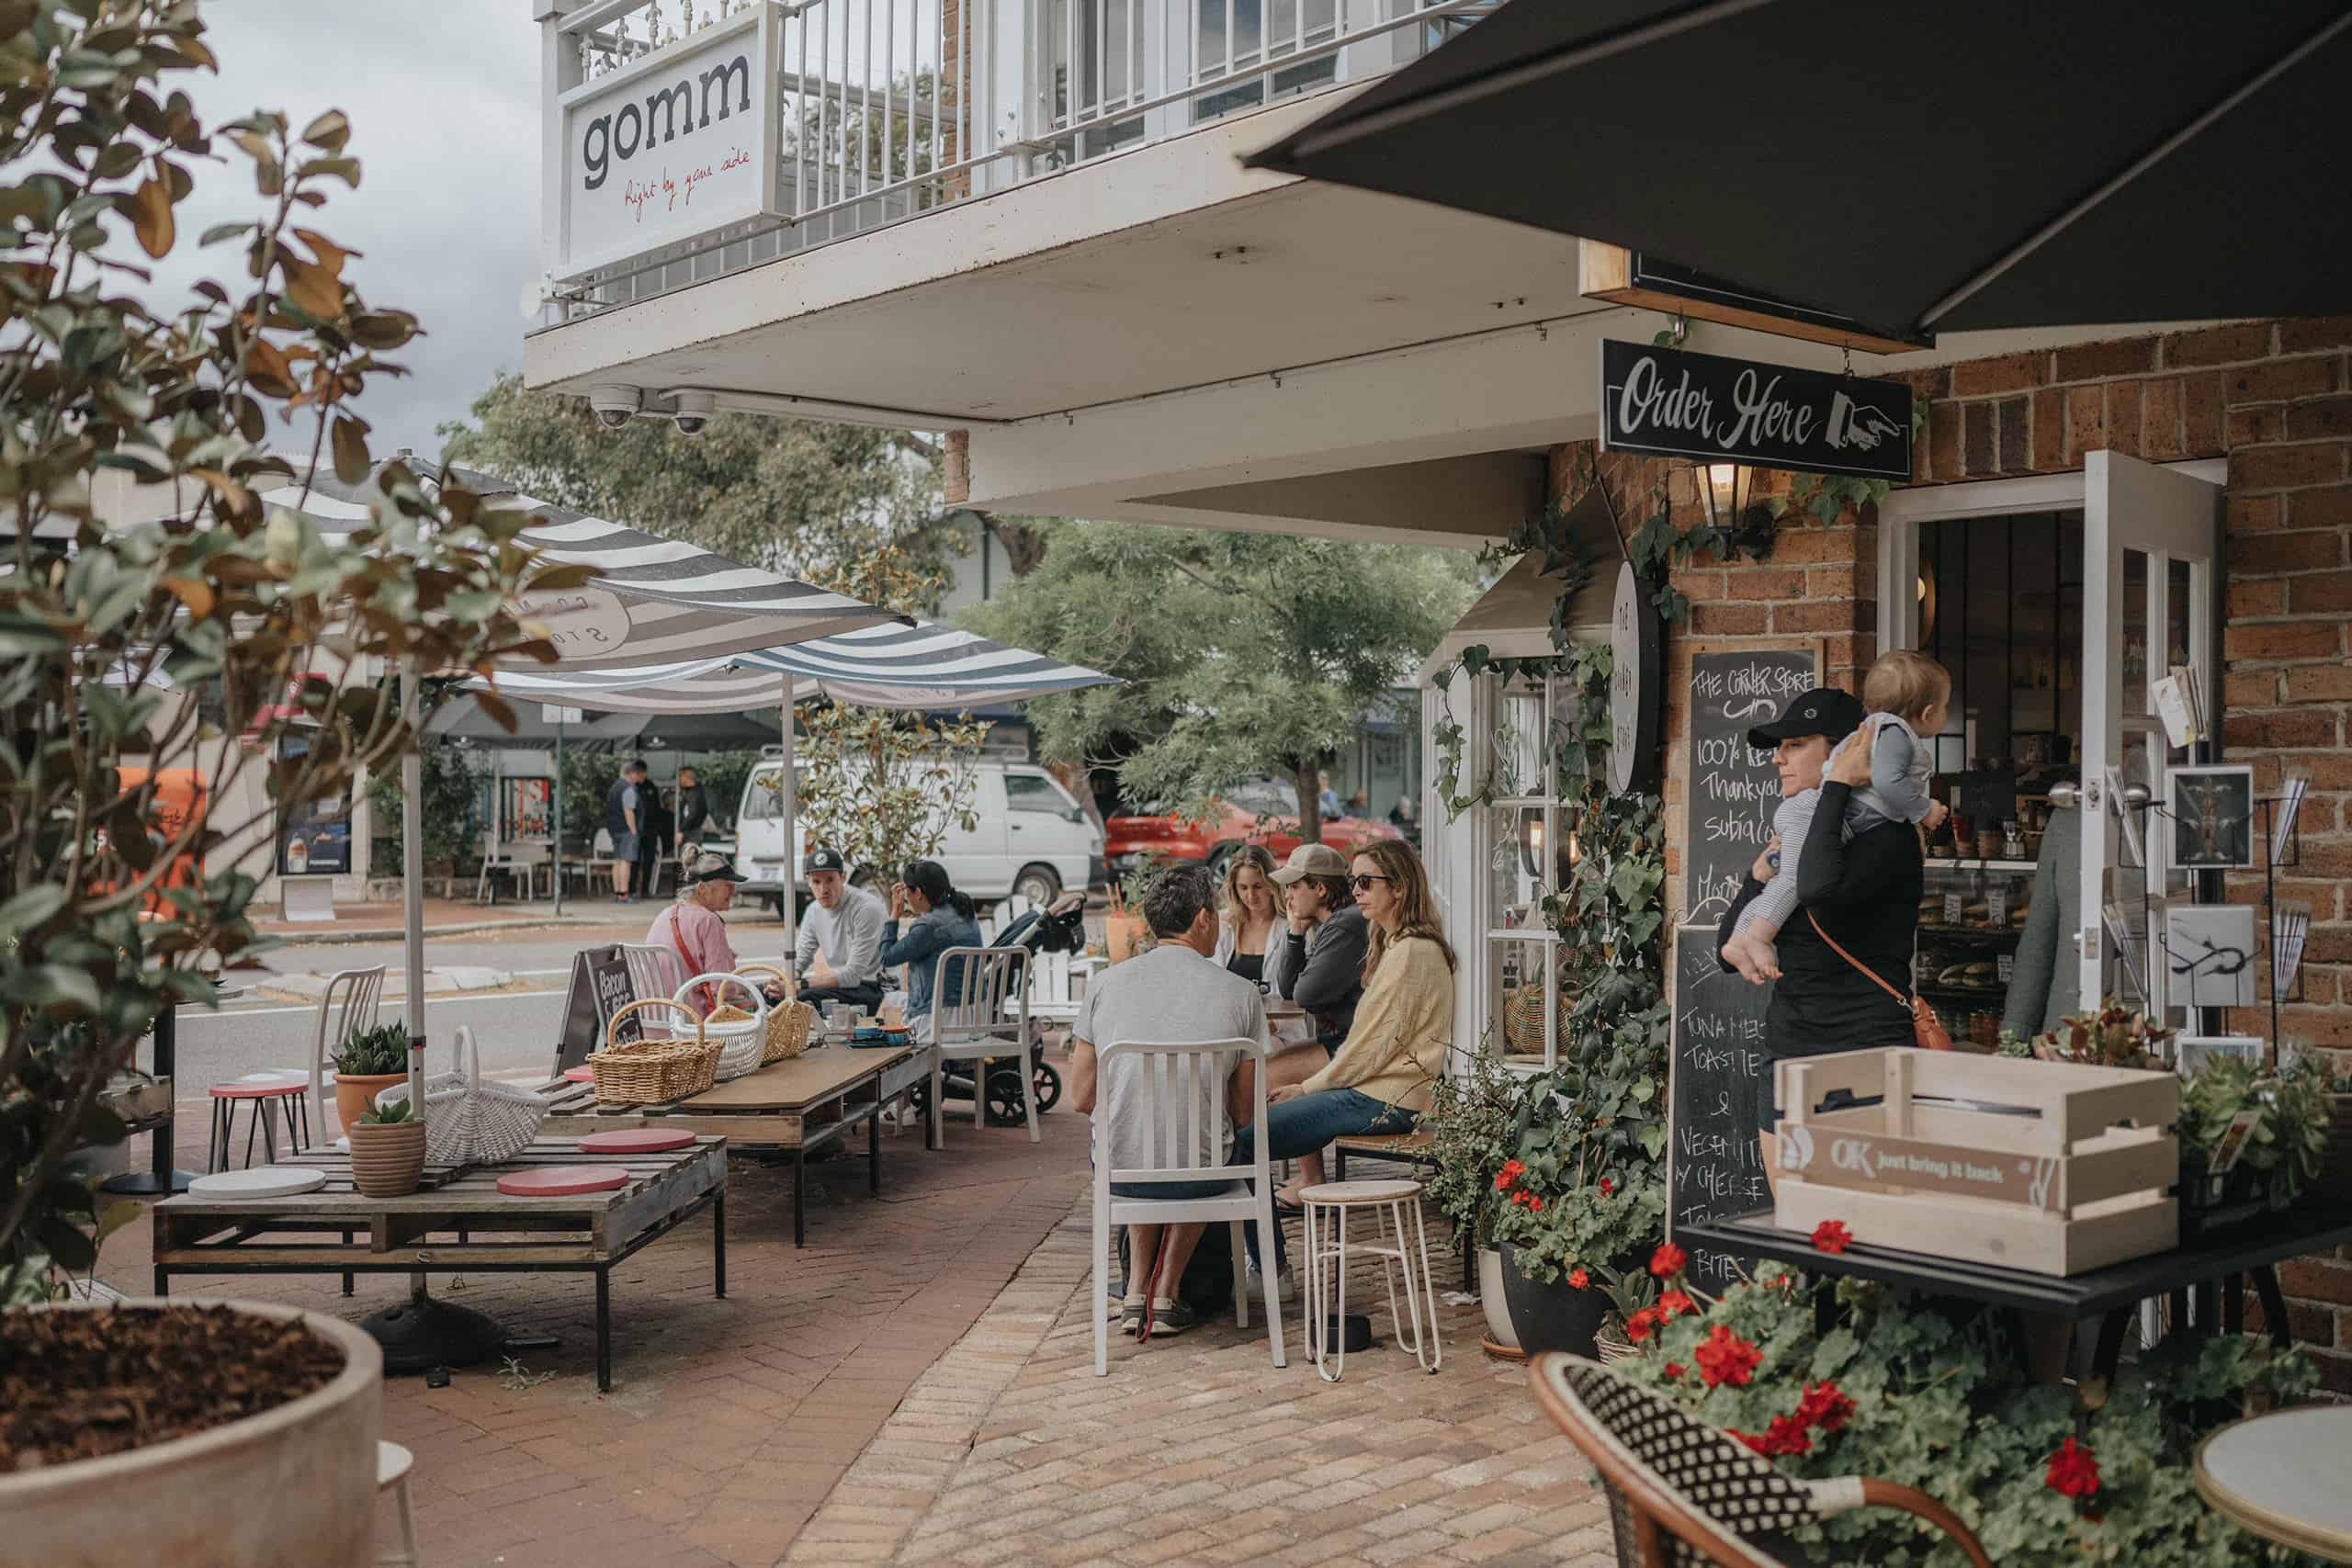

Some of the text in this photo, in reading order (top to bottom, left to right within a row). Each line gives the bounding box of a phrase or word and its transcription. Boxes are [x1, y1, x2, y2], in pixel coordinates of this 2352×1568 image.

[583, 55, 751, 190] gomm
[662, 165, 677, 212] by
[684, 164, 713, 206] your
[720, 146, 750, 172] side
[1619, 355, 1824, 449] Order Here
[1690, 660, 1816, 698] THE CORNER STORE
[1698, 732, 1740, 770] 100%
[1679, 1007, 1727, 1040] TUNA
[1830, 1138, 1877, 1179] OK
[1908, 1154, 1948, 1180] bring
[1951, 1161, 1963, 1178] it
